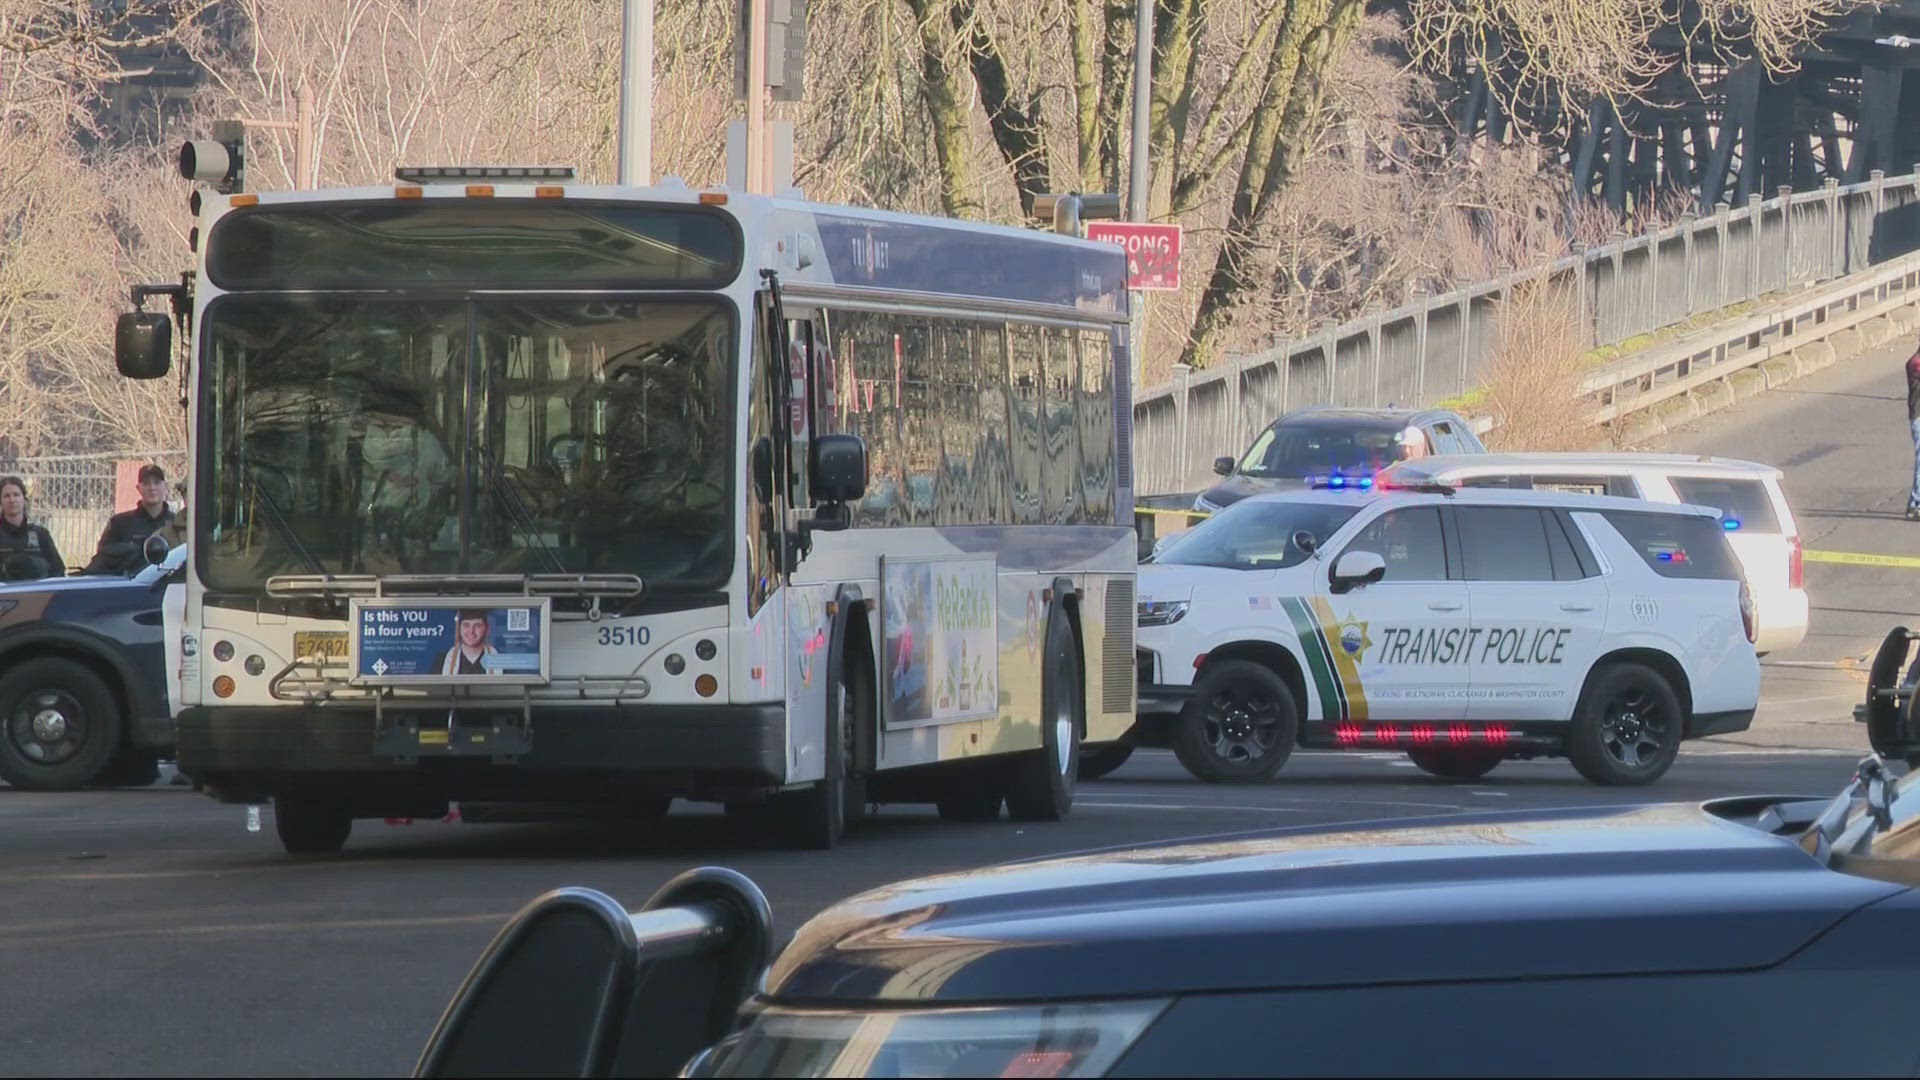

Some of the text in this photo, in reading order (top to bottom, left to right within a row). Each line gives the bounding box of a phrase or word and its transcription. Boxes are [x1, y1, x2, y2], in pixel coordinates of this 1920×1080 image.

[364, 610, 428, 622] Is this YOU
[1635, 603, 1654, 615] 911
[364, 624, 445, 639] in four years?
[598, 626, 650, 646] 3510
[1378, 628, 1572, 664] TRANSIT POLICE
